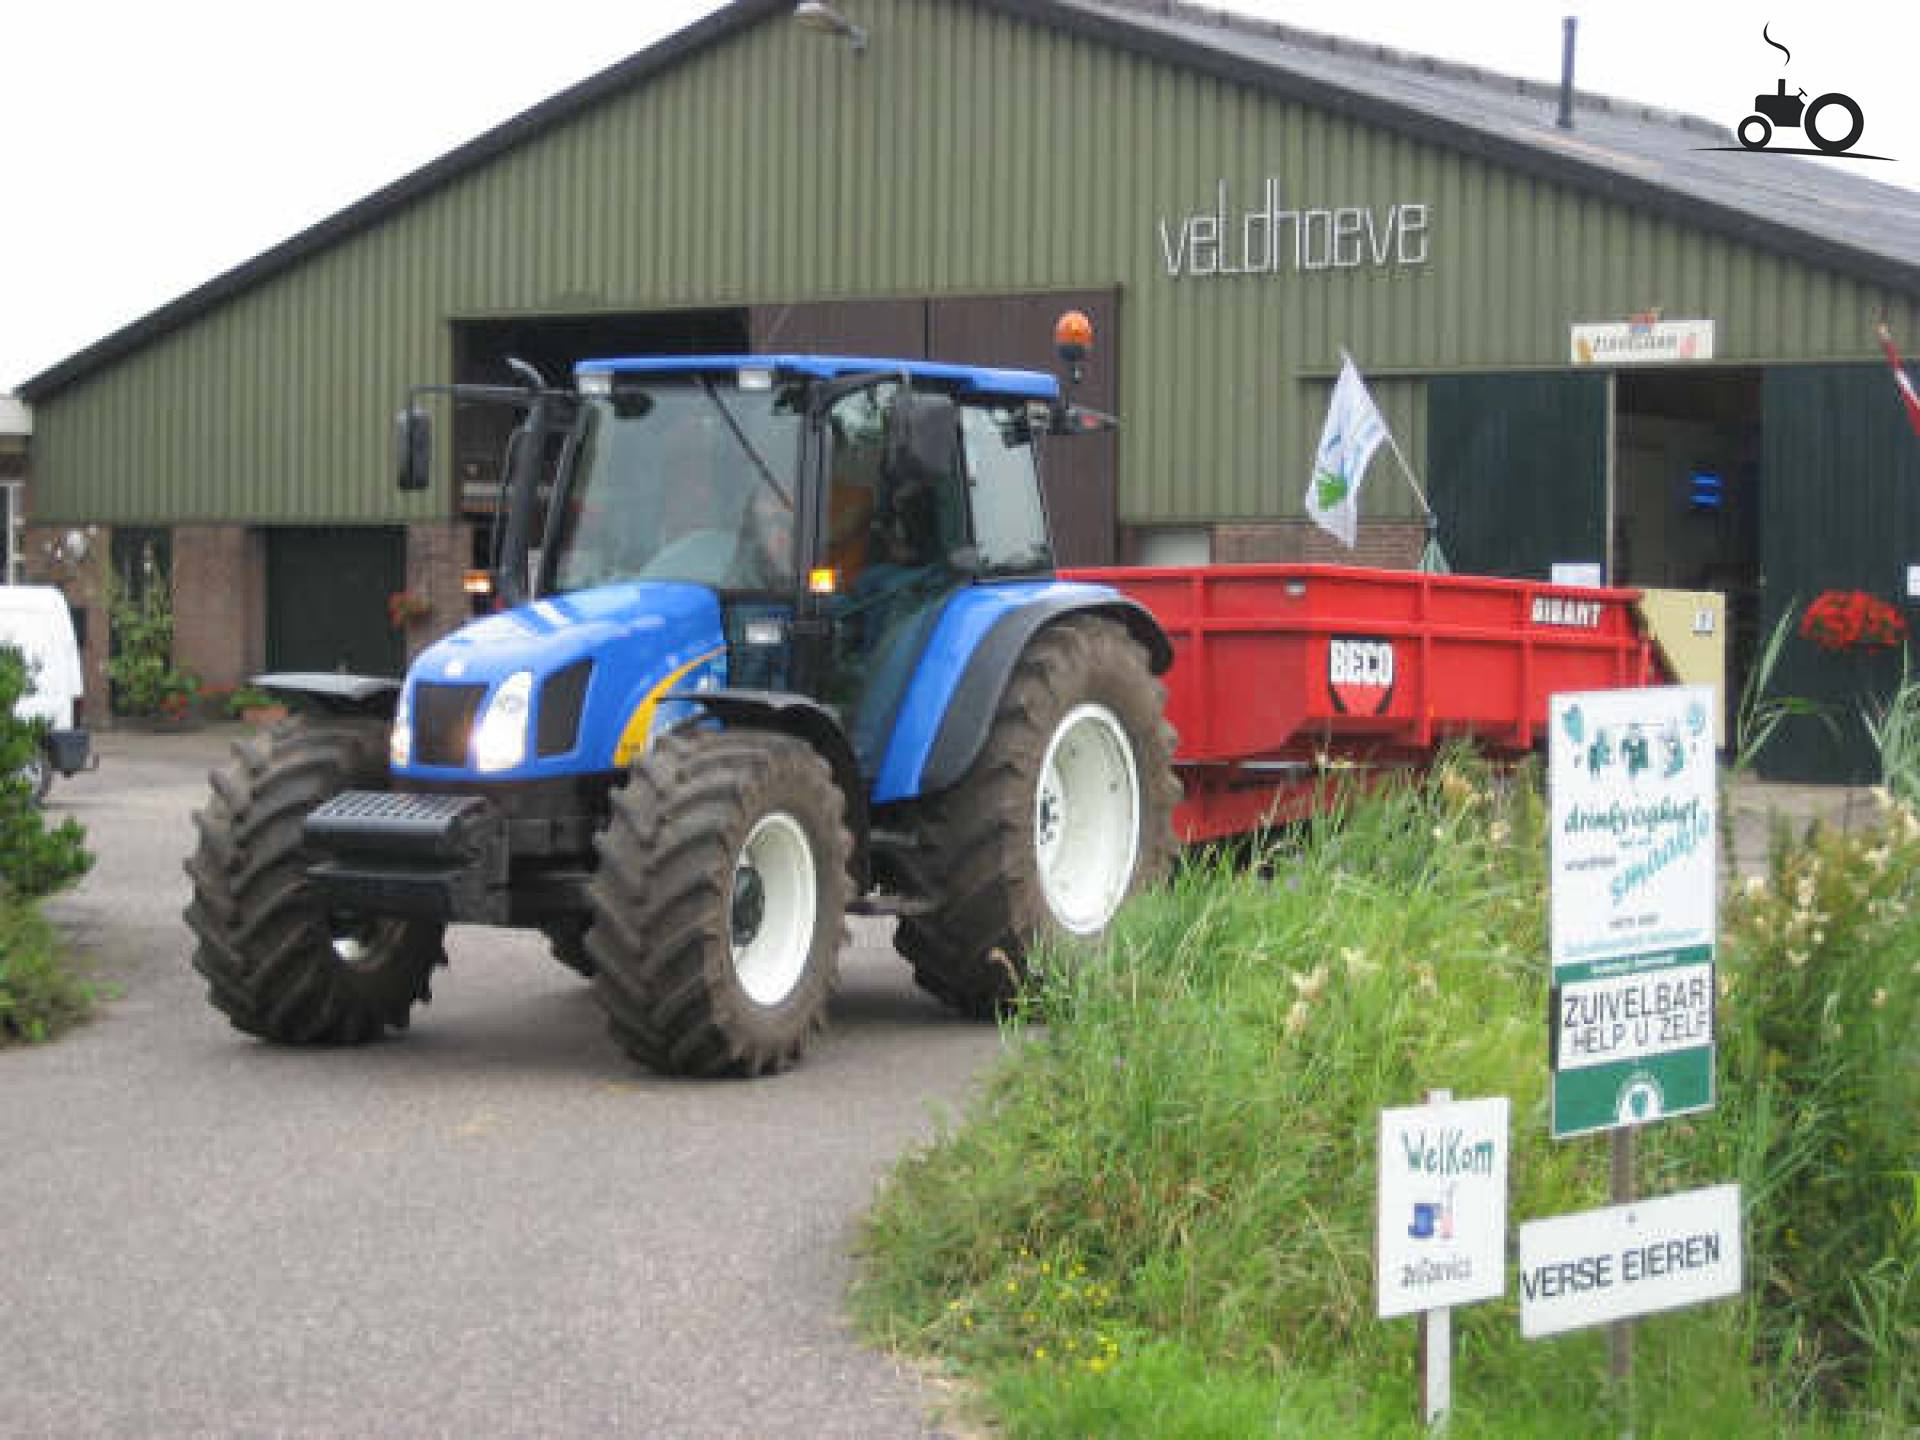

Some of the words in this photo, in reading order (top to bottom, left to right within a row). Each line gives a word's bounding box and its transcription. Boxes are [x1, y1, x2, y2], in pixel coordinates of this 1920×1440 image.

[1329, 640, 1394, 685] BECO
[1564, 977, 1704, 1028] ZUIVELBAR
[1570, 1023, 1628, 1056] HELP
[1634, 1017, 1651, 1047] U
[1658, 1009, 1708, 1042] ZELF
[1520, 1254, 1613, 1301] VERSE
[1621, 1231, 1720, 1281] EIEREN
